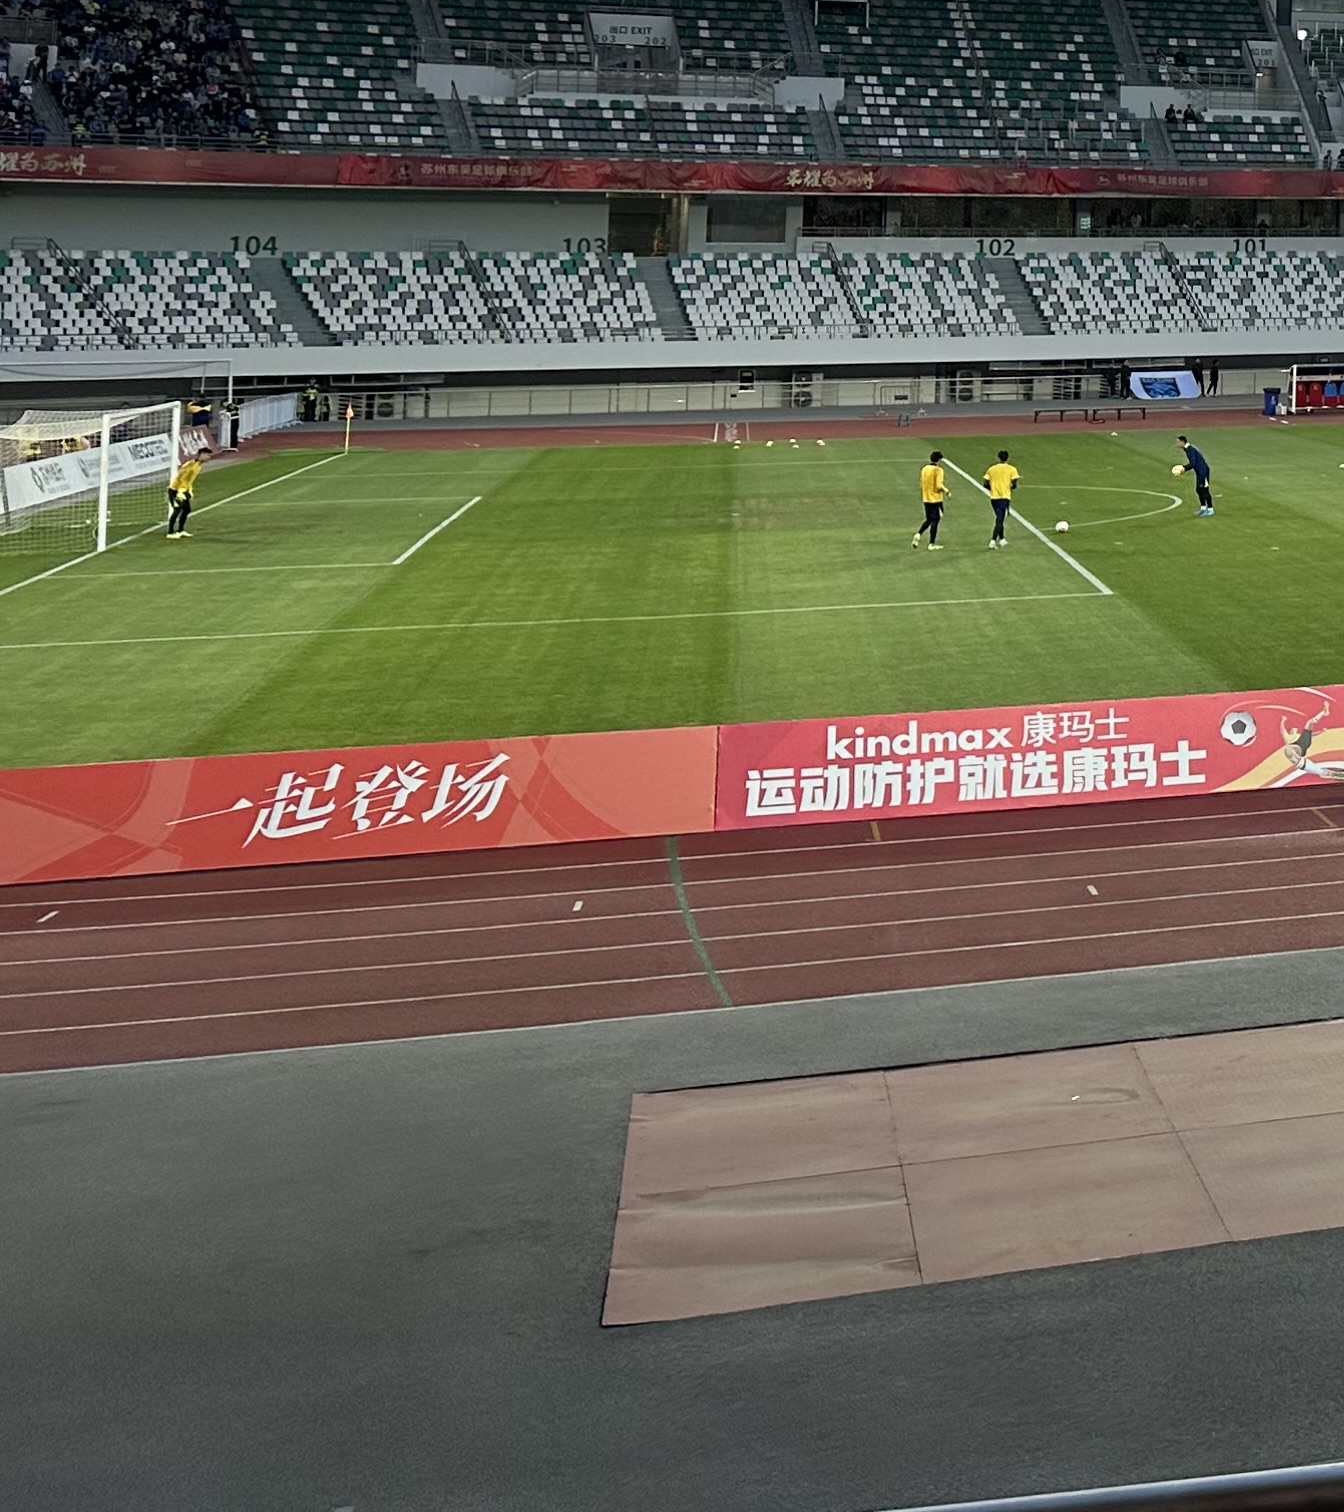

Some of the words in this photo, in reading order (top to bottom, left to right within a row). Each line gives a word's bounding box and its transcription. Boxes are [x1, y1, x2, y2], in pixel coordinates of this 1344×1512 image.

[631, 26, 652, 35] EXIT
[230, 235, 278, 256] 104
[563, 237, 606, 255] 103
[976, 239, 1015, 256] 102
[1233, 238, 1266, 254] 101
[826, 720, 1014, 761] kindmax
[1021, 709, 1130, 749] 康玛士
[744, 739, 1207, 817] 运动防护就选康玛士
[166, 752, 511, 848] 一起登场
